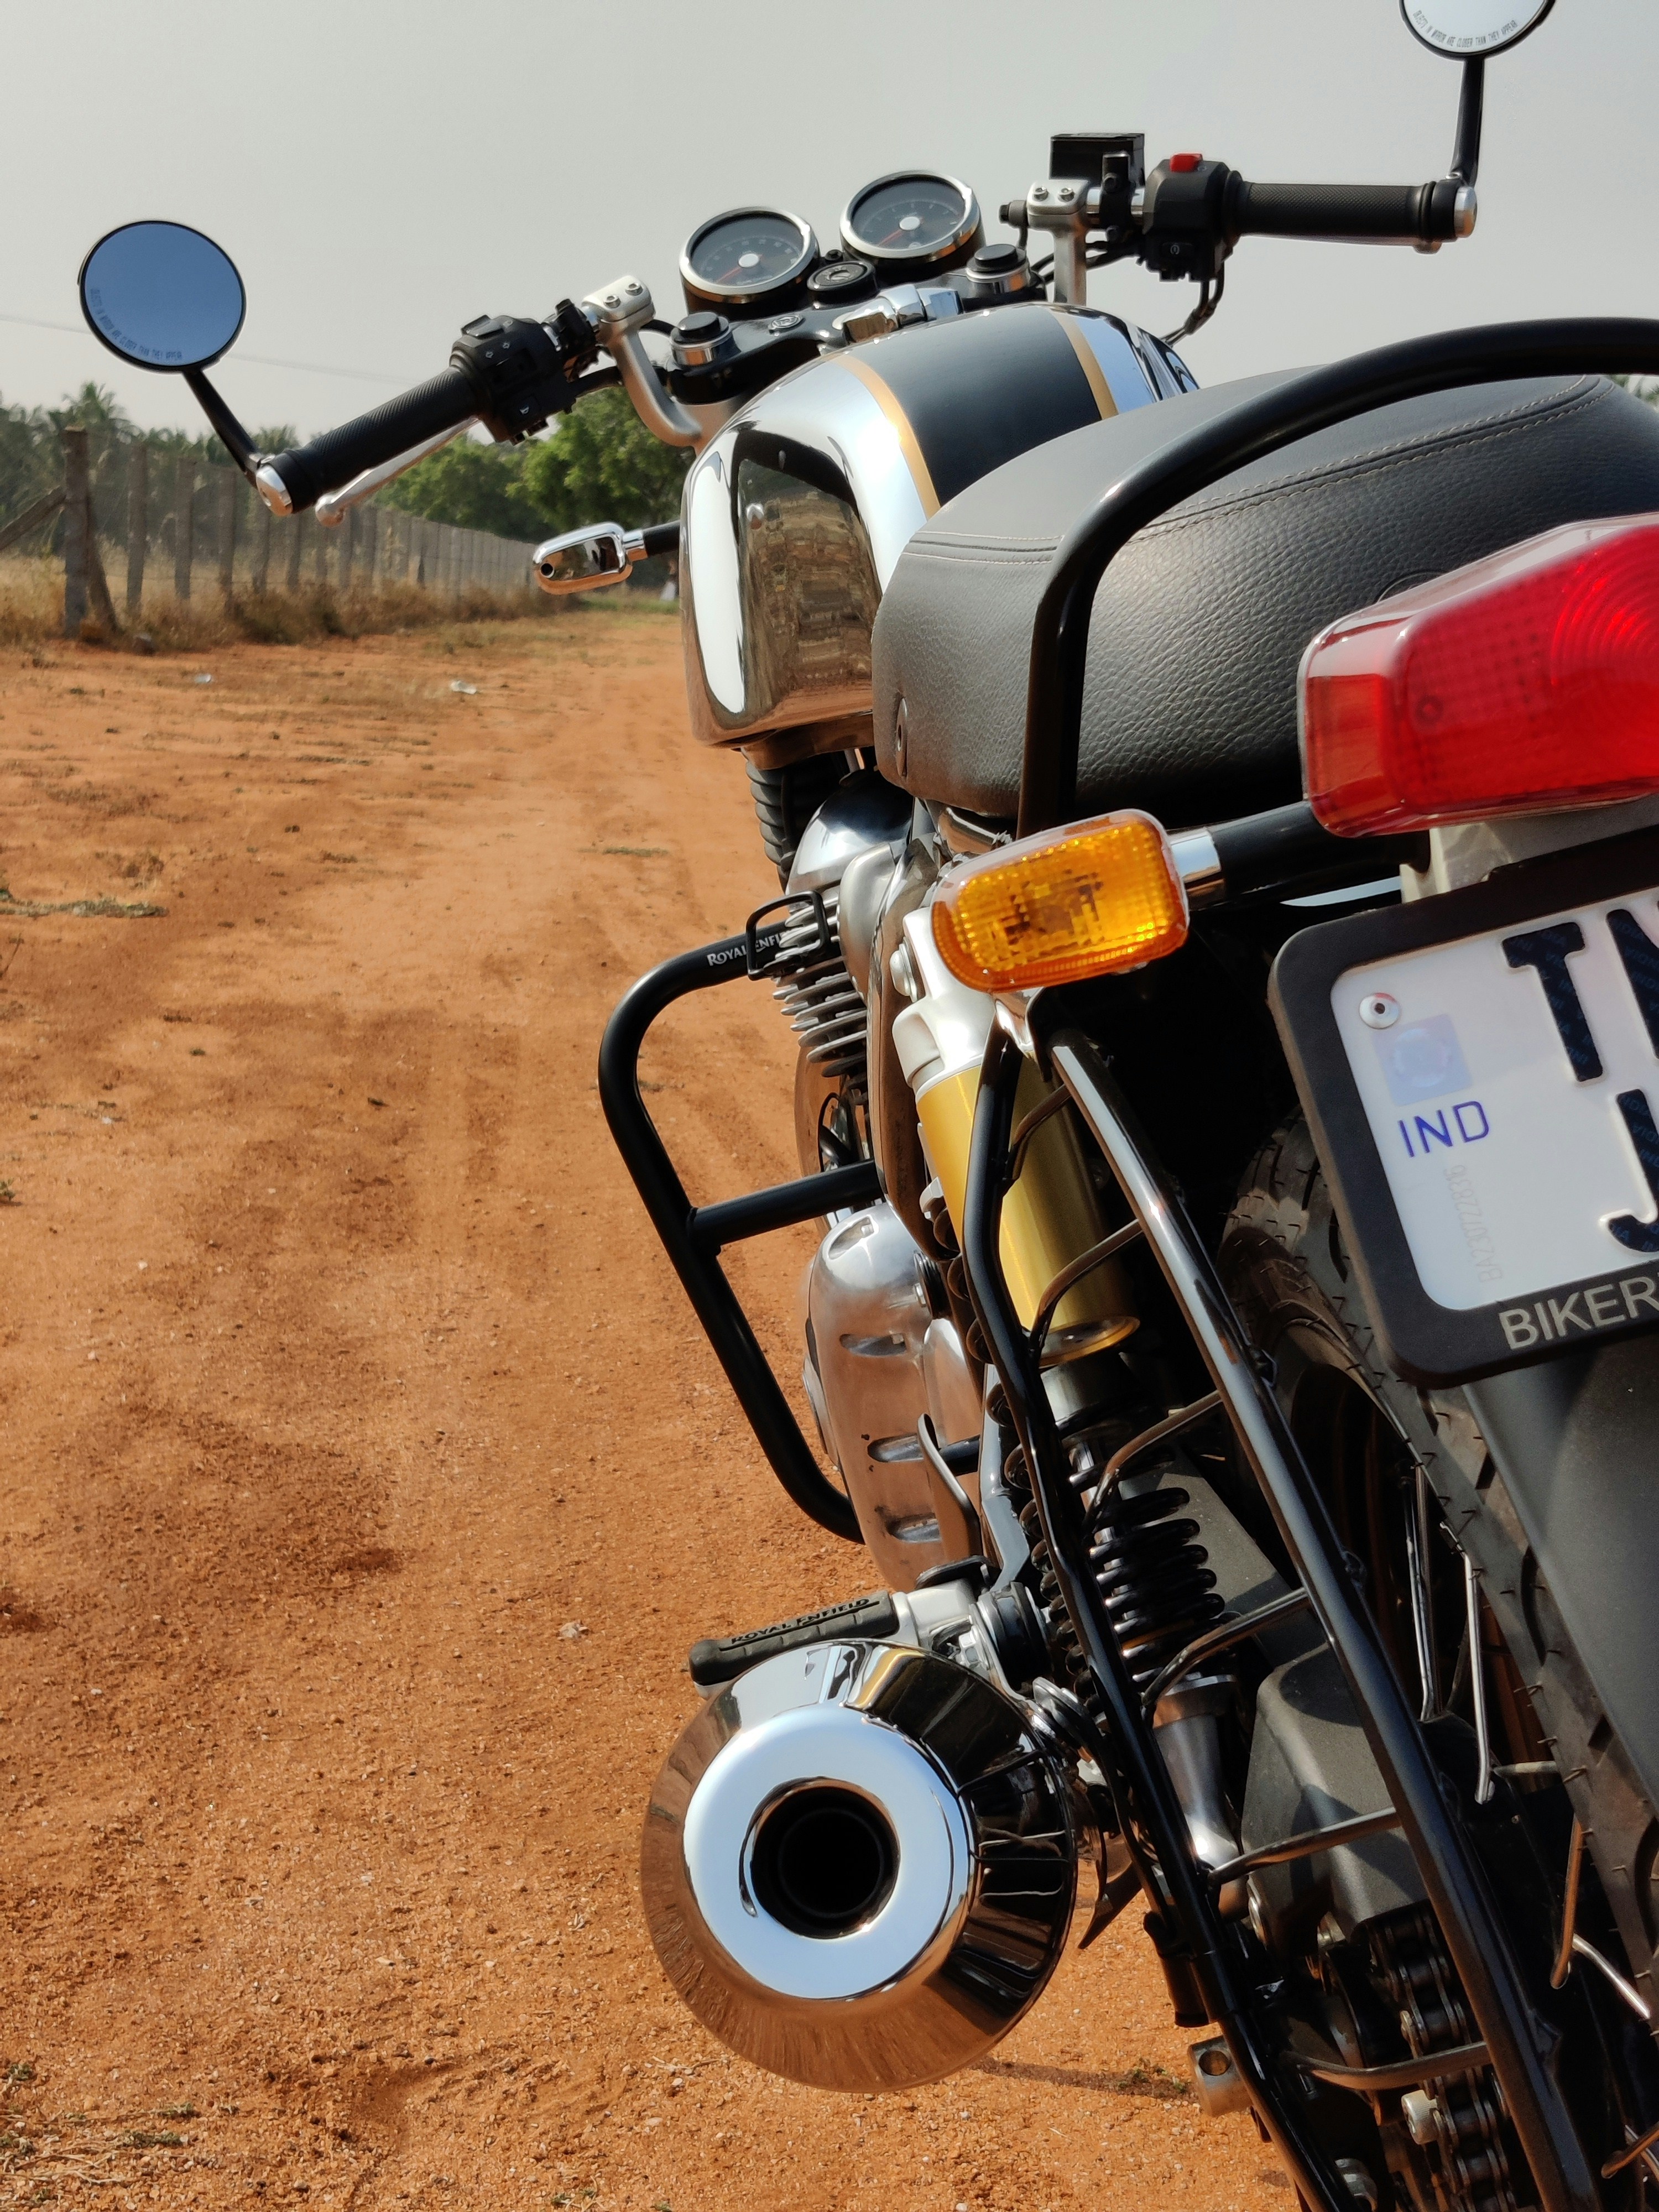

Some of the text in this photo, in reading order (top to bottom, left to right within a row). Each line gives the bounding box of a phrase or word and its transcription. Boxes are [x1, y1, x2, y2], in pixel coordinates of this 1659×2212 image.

[707, 933, 780, 966] ROYAL ENFI
[1399, 1101, 1489, 1157] IND
[1499, 1272, 1659, 1349] BIKER
[731, 1598, 870, 1644] ROYAL ENFIELD
